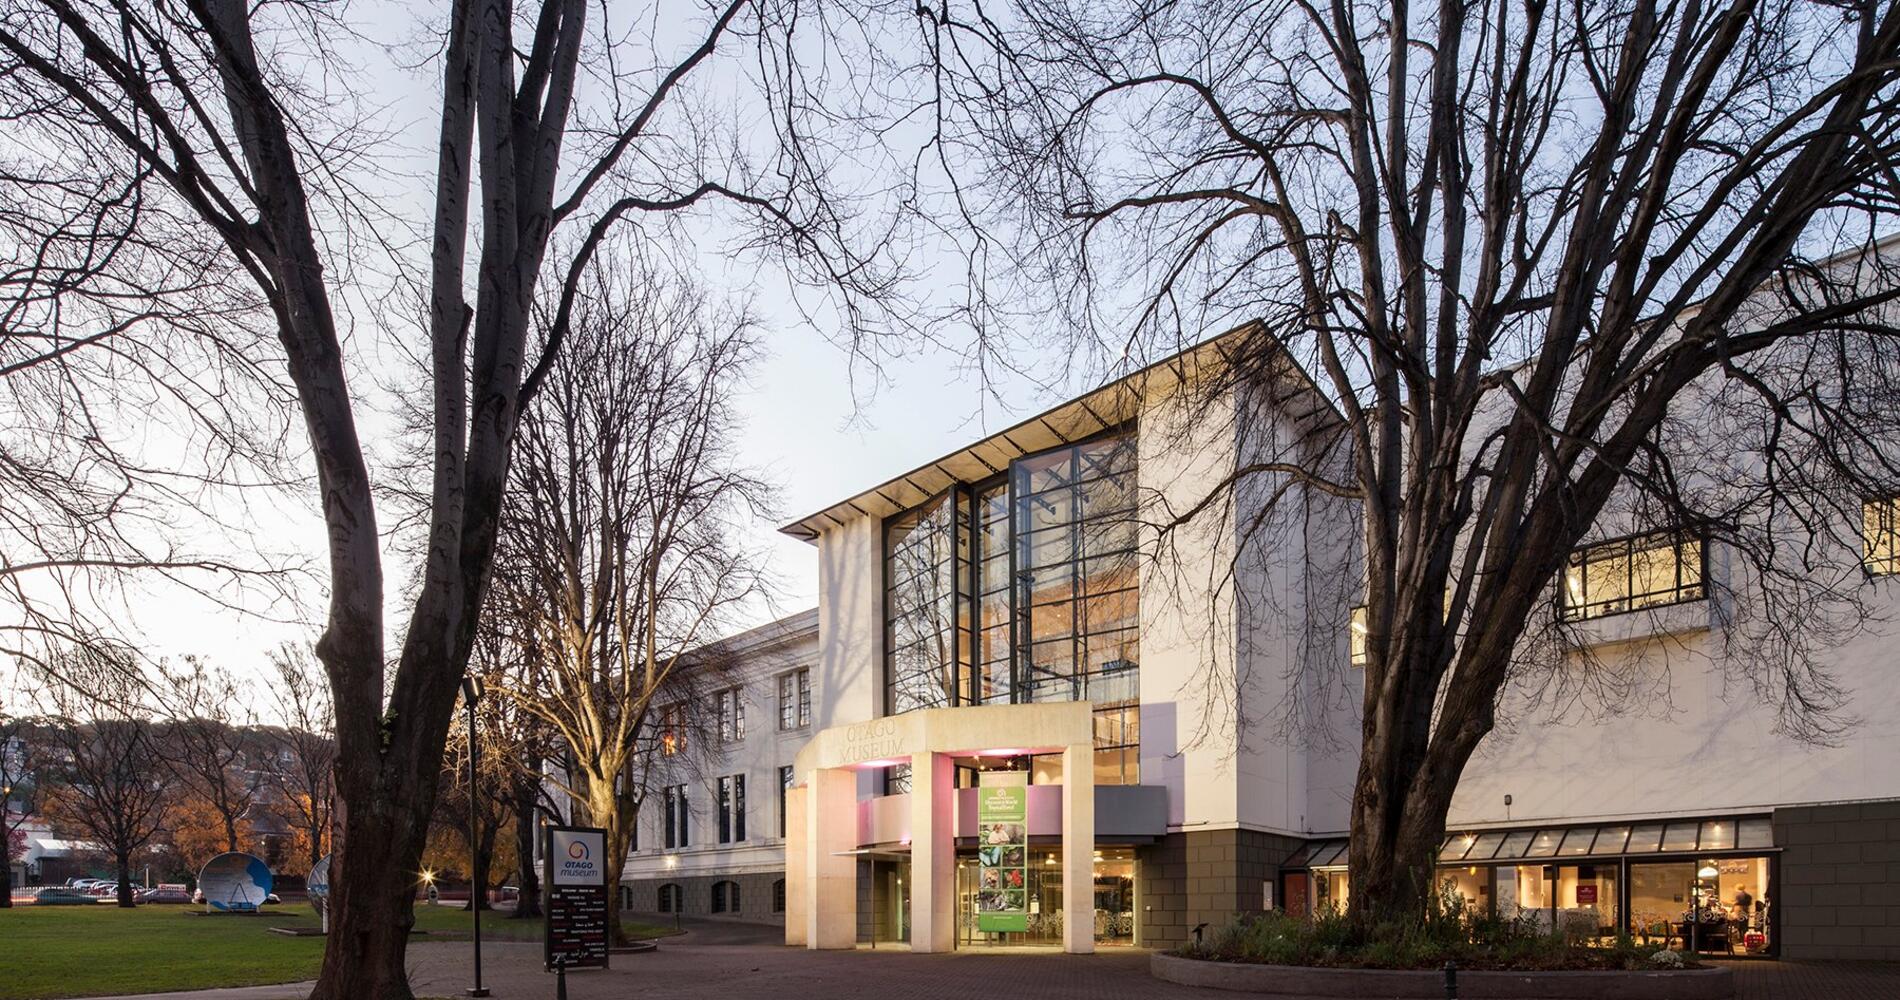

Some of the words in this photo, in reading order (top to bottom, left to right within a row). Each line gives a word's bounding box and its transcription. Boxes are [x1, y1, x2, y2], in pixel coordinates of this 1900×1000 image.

[847, 719, 895, 742] OTAGO
[840, 738, 904, 763] MUSEUM
[565, 861, 593, 869] OTAGO
[560, 869, 598, 877] museum
